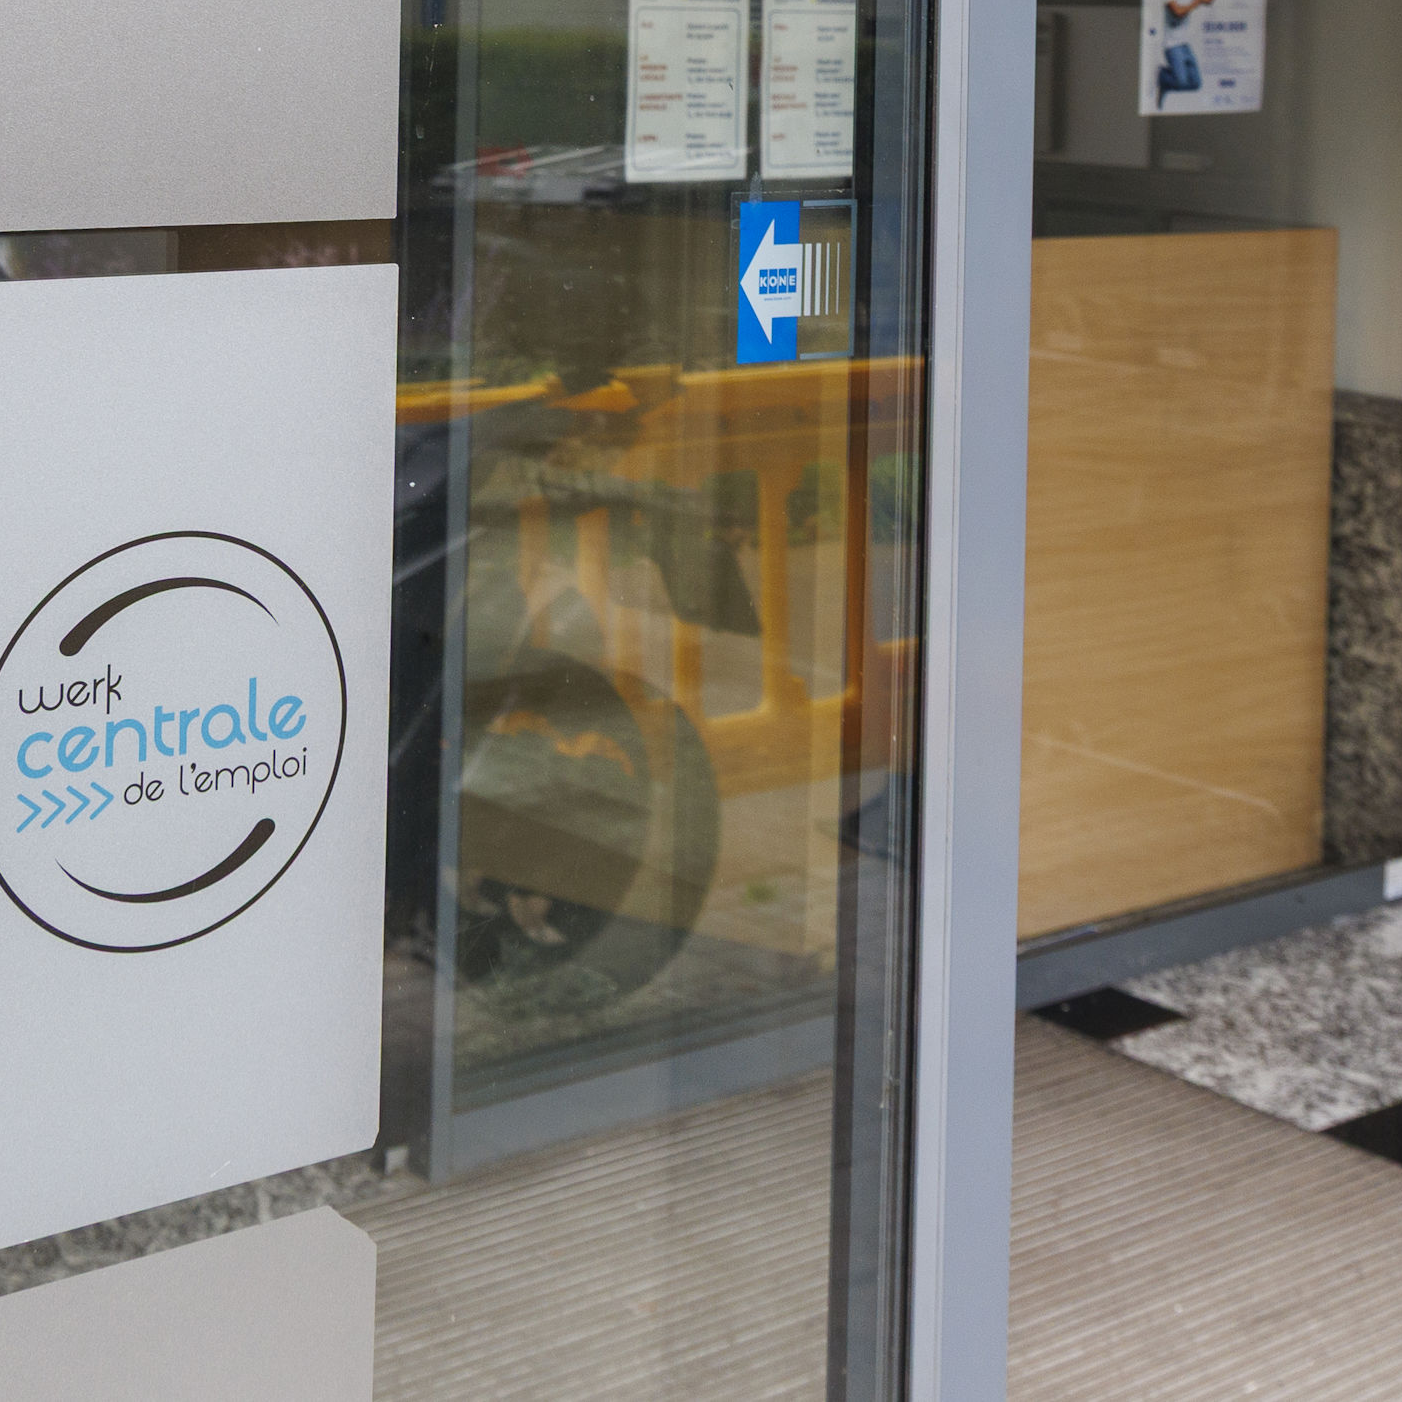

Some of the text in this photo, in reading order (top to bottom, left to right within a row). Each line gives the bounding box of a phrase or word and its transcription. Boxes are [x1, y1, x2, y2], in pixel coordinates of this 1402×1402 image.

[759, 275, 796, 288] KONE
[17, 663, 123, 716] werk
[16, 676, 308, 781] centrale
[123, 746, 309, 806] de l'emploi
